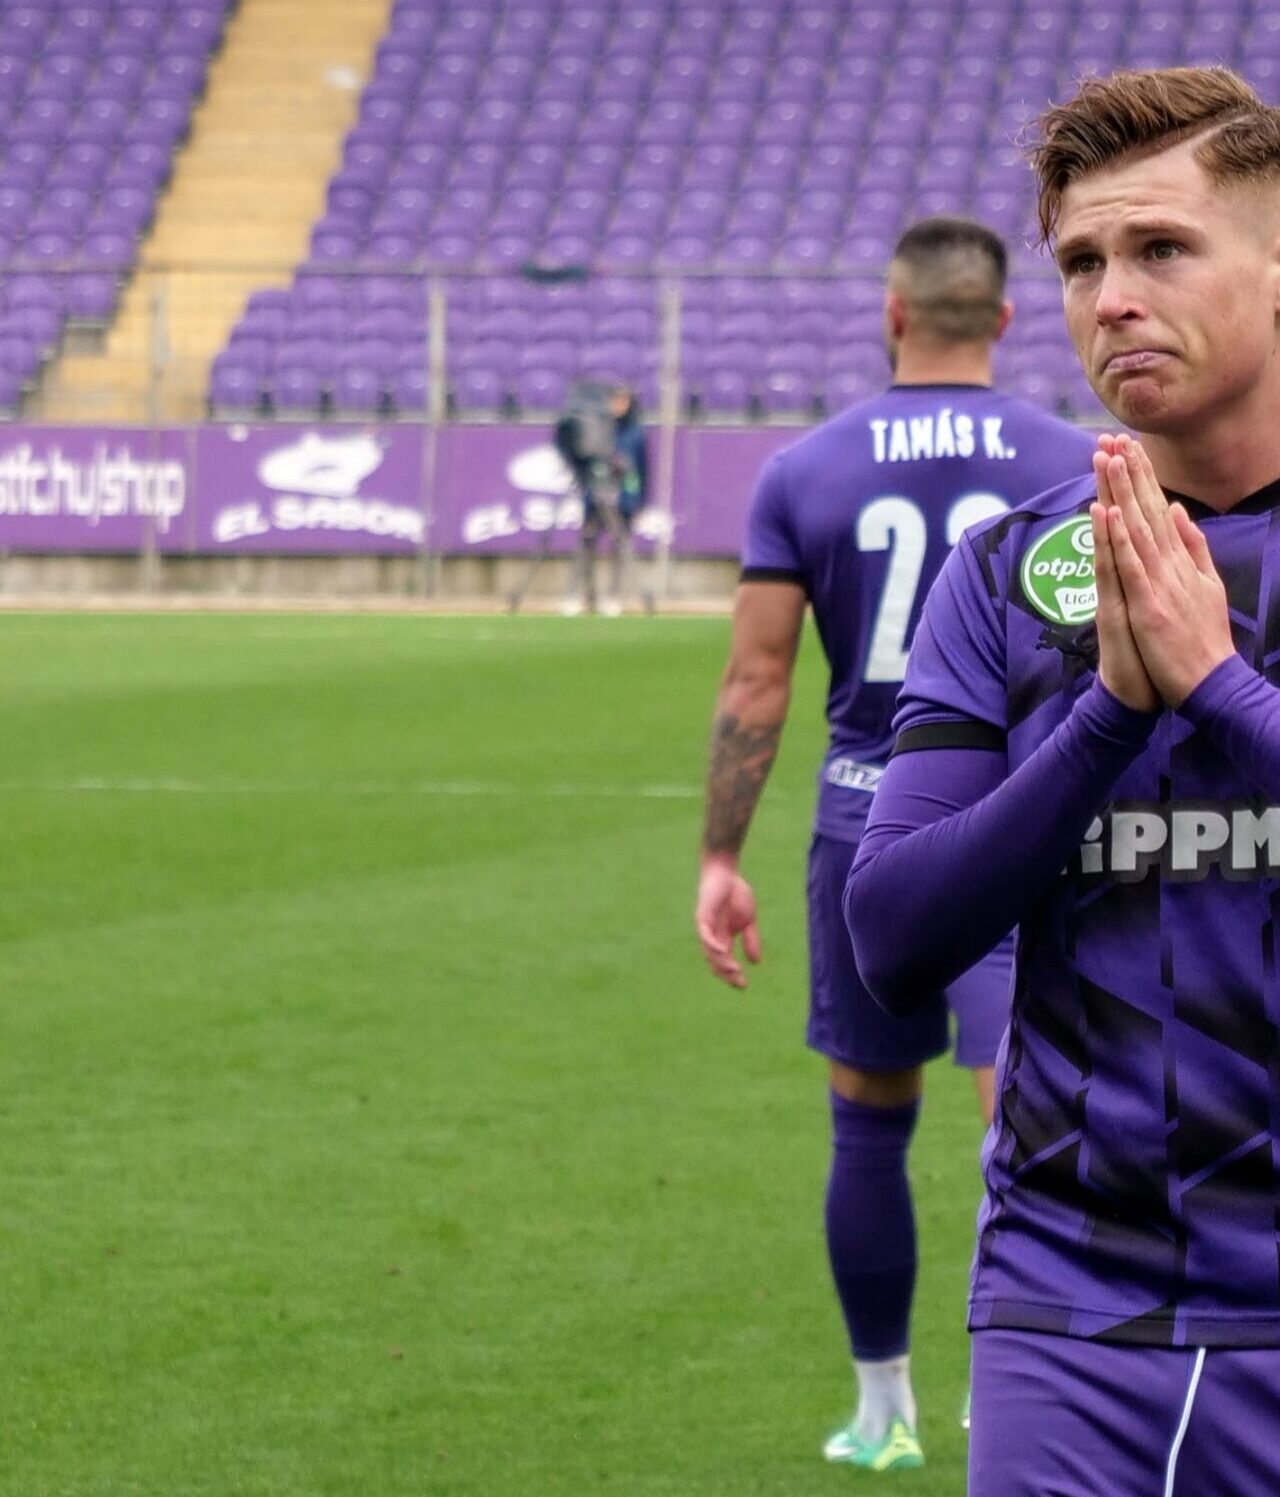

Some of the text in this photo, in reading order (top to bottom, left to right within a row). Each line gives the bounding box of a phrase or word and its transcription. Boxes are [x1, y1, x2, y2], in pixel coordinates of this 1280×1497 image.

[869, 407, 1017, 463] TAMÁS K.
[213, 496, 425, 544] EL SABOR
[463, 503, 520, 544] EL
[1033, 556, 1096, 582] otpb
[1064, 592, 1096, 605] LIGA
